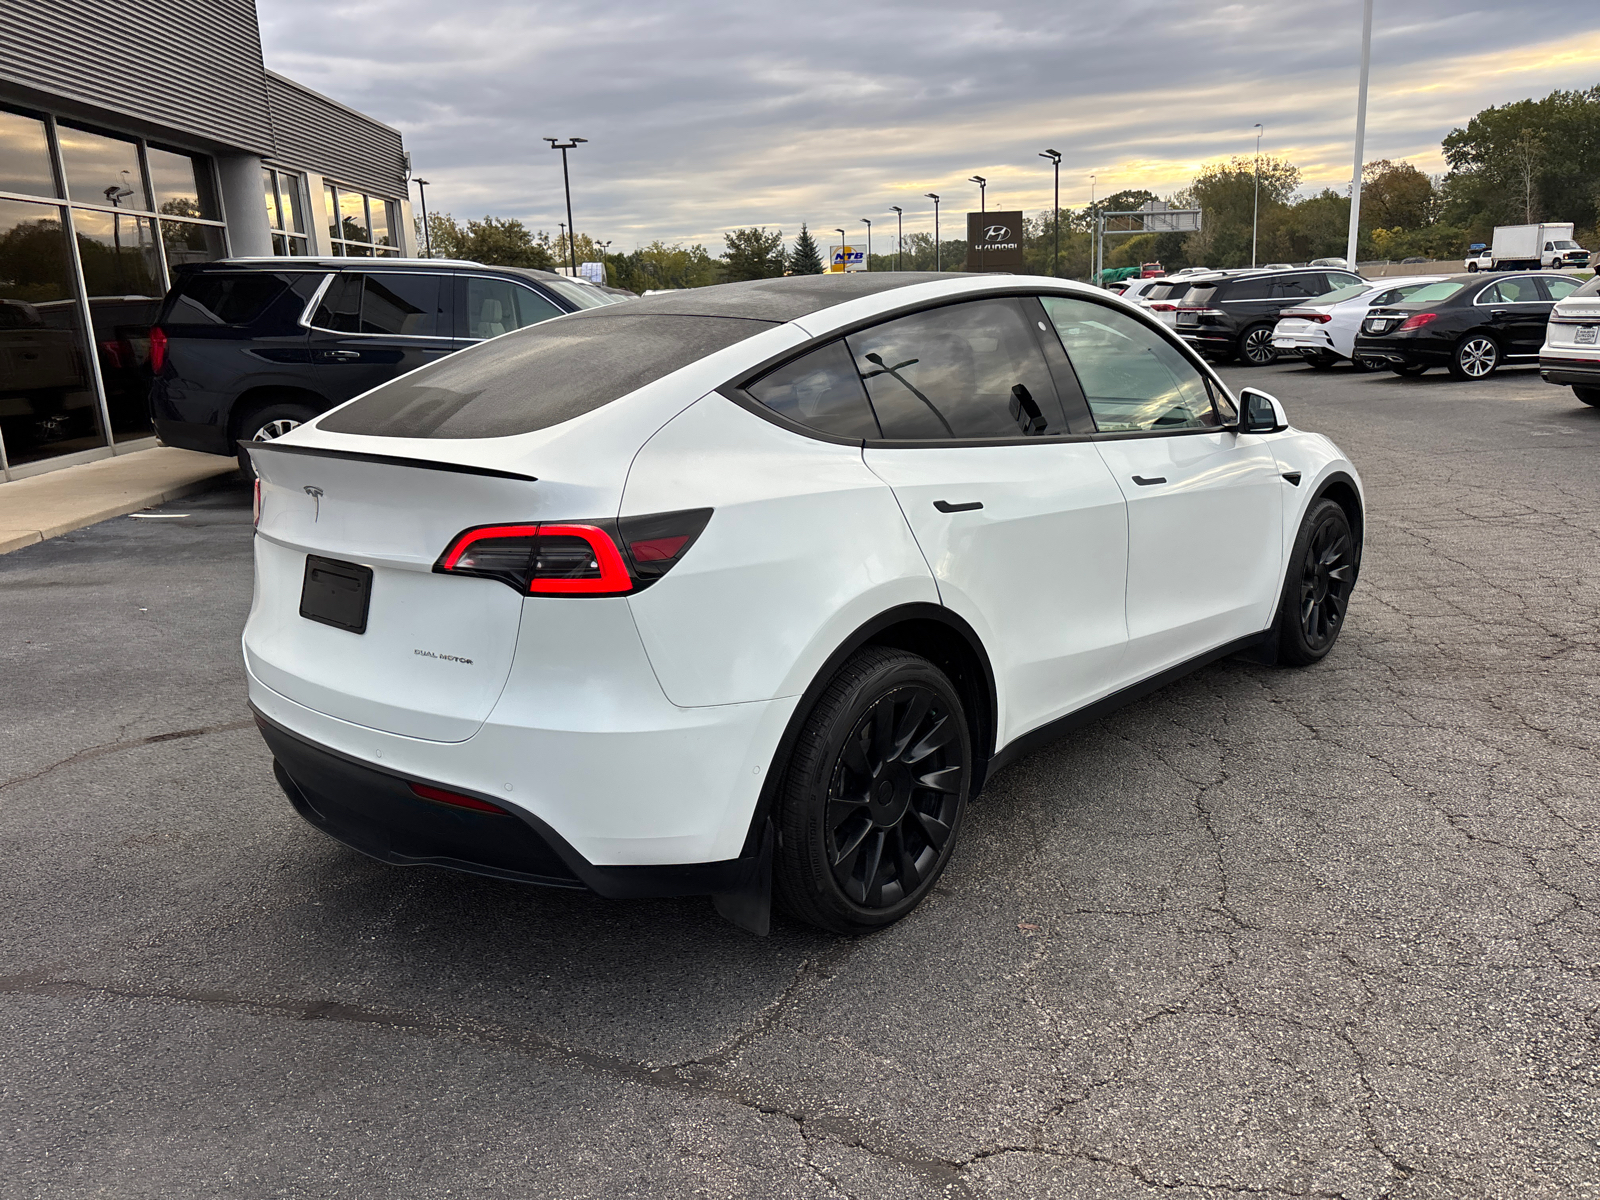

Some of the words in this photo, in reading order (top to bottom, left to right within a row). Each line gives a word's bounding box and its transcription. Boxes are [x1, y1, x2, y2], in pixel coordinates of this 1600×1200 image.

[834, 252, 864, 260] NTB
[414, 649, 438, 659] DUAL
[439, 653, 474, 665] MOTOR
